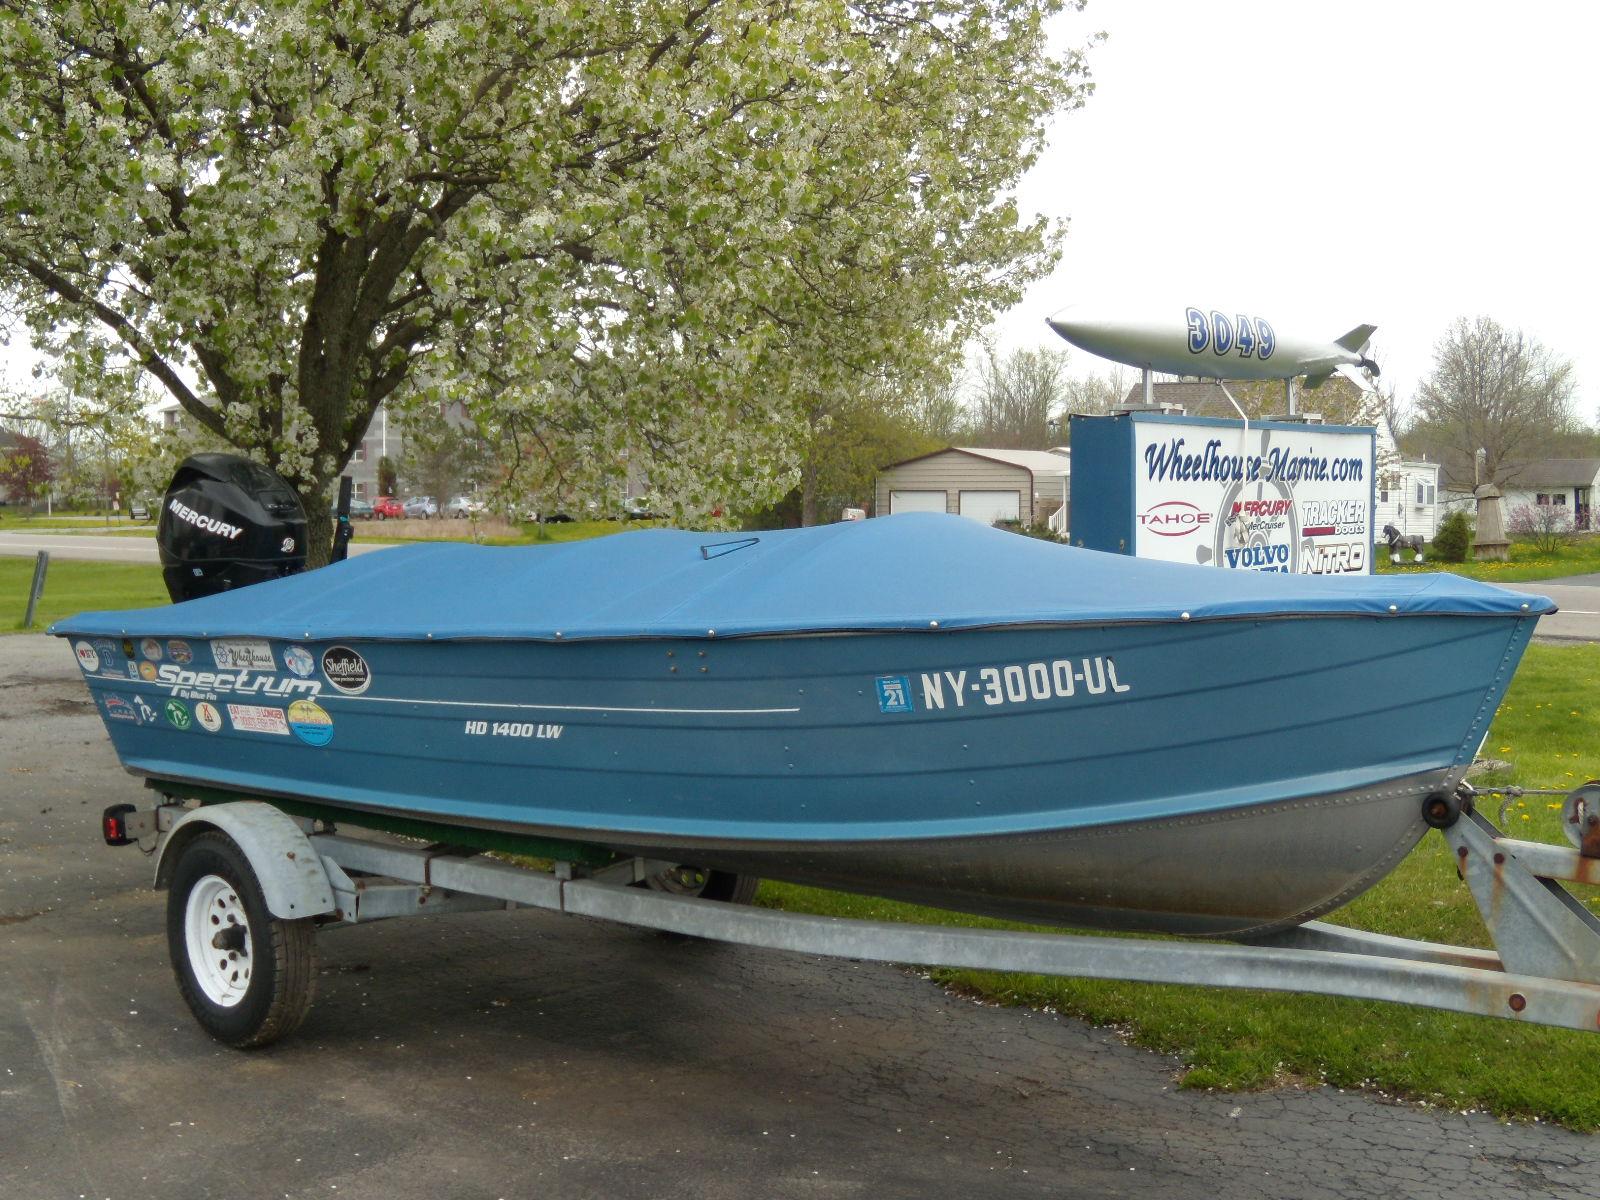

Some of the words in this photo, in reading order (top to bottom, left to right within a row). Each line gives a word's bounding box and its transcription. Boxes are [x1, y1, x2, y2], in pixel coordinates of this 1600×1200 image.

[1186, 307, 1275, 360] 3049
[1145, 438, 1261, 482] Wheelhouse
[1266, 446, 1363, 482] Marine.com
[169, 499, 243, 540] MERCURY
[1137, 512, 1211, 525] TAHOE
[1302, 500, 1365, 526] TRACKER
[1334, 525, 1365, 535] boats
[1225, 544, 1289, 569] VOLVO
[325, 658, 364, 676] Sheffield
[158, 664, 322, 701] Spectrum
[180, 689, 190, 699] By
[190, 690, 206, 700] Blue
[206, 691, 217, 701] Fin
[884, 690, 905, 705] 21
[465, 720, 487, 735] HD
[492, 722, 534, 738] 1400
[536, 724, 563, 739] LW
